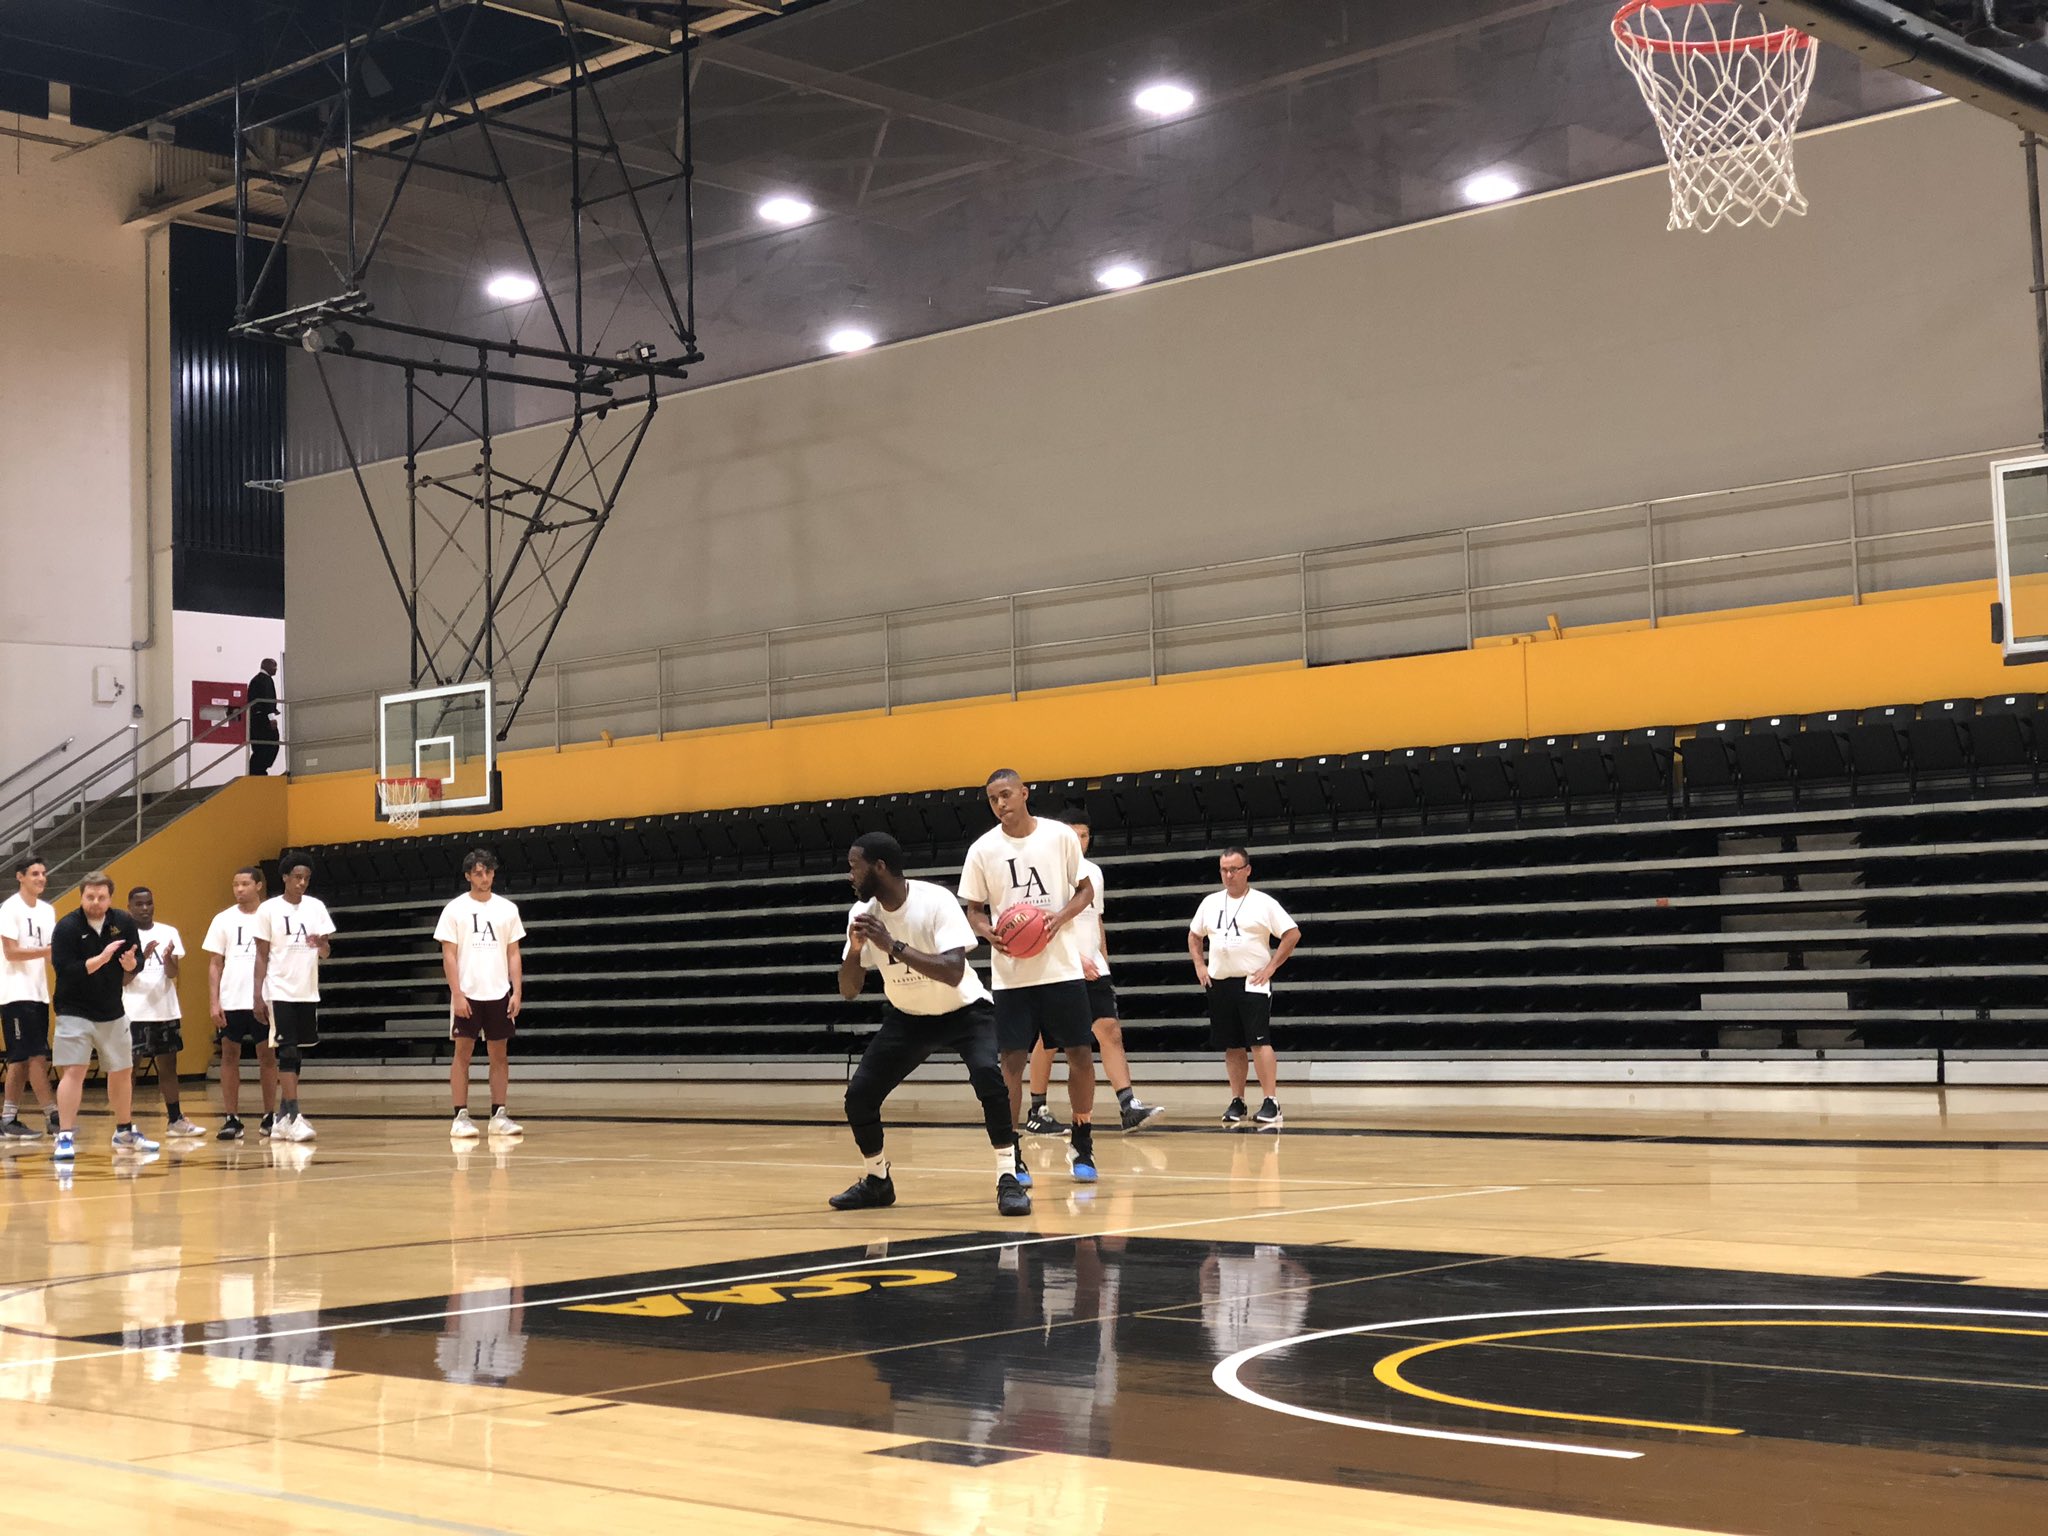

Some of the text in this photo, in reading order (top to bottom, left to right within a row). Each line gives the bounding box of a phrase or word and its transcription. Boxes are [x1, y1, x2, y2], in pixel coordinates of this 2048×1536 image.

[1005, 857, 1050, 898] LA
[26, 917, 44, 947] LA
[283, 915, 309, 943] LA
[471, 912, 498, 942] LA
[1216, 910, 1241, 937] LA
[557, 1268, 958, 1318] CCAA
